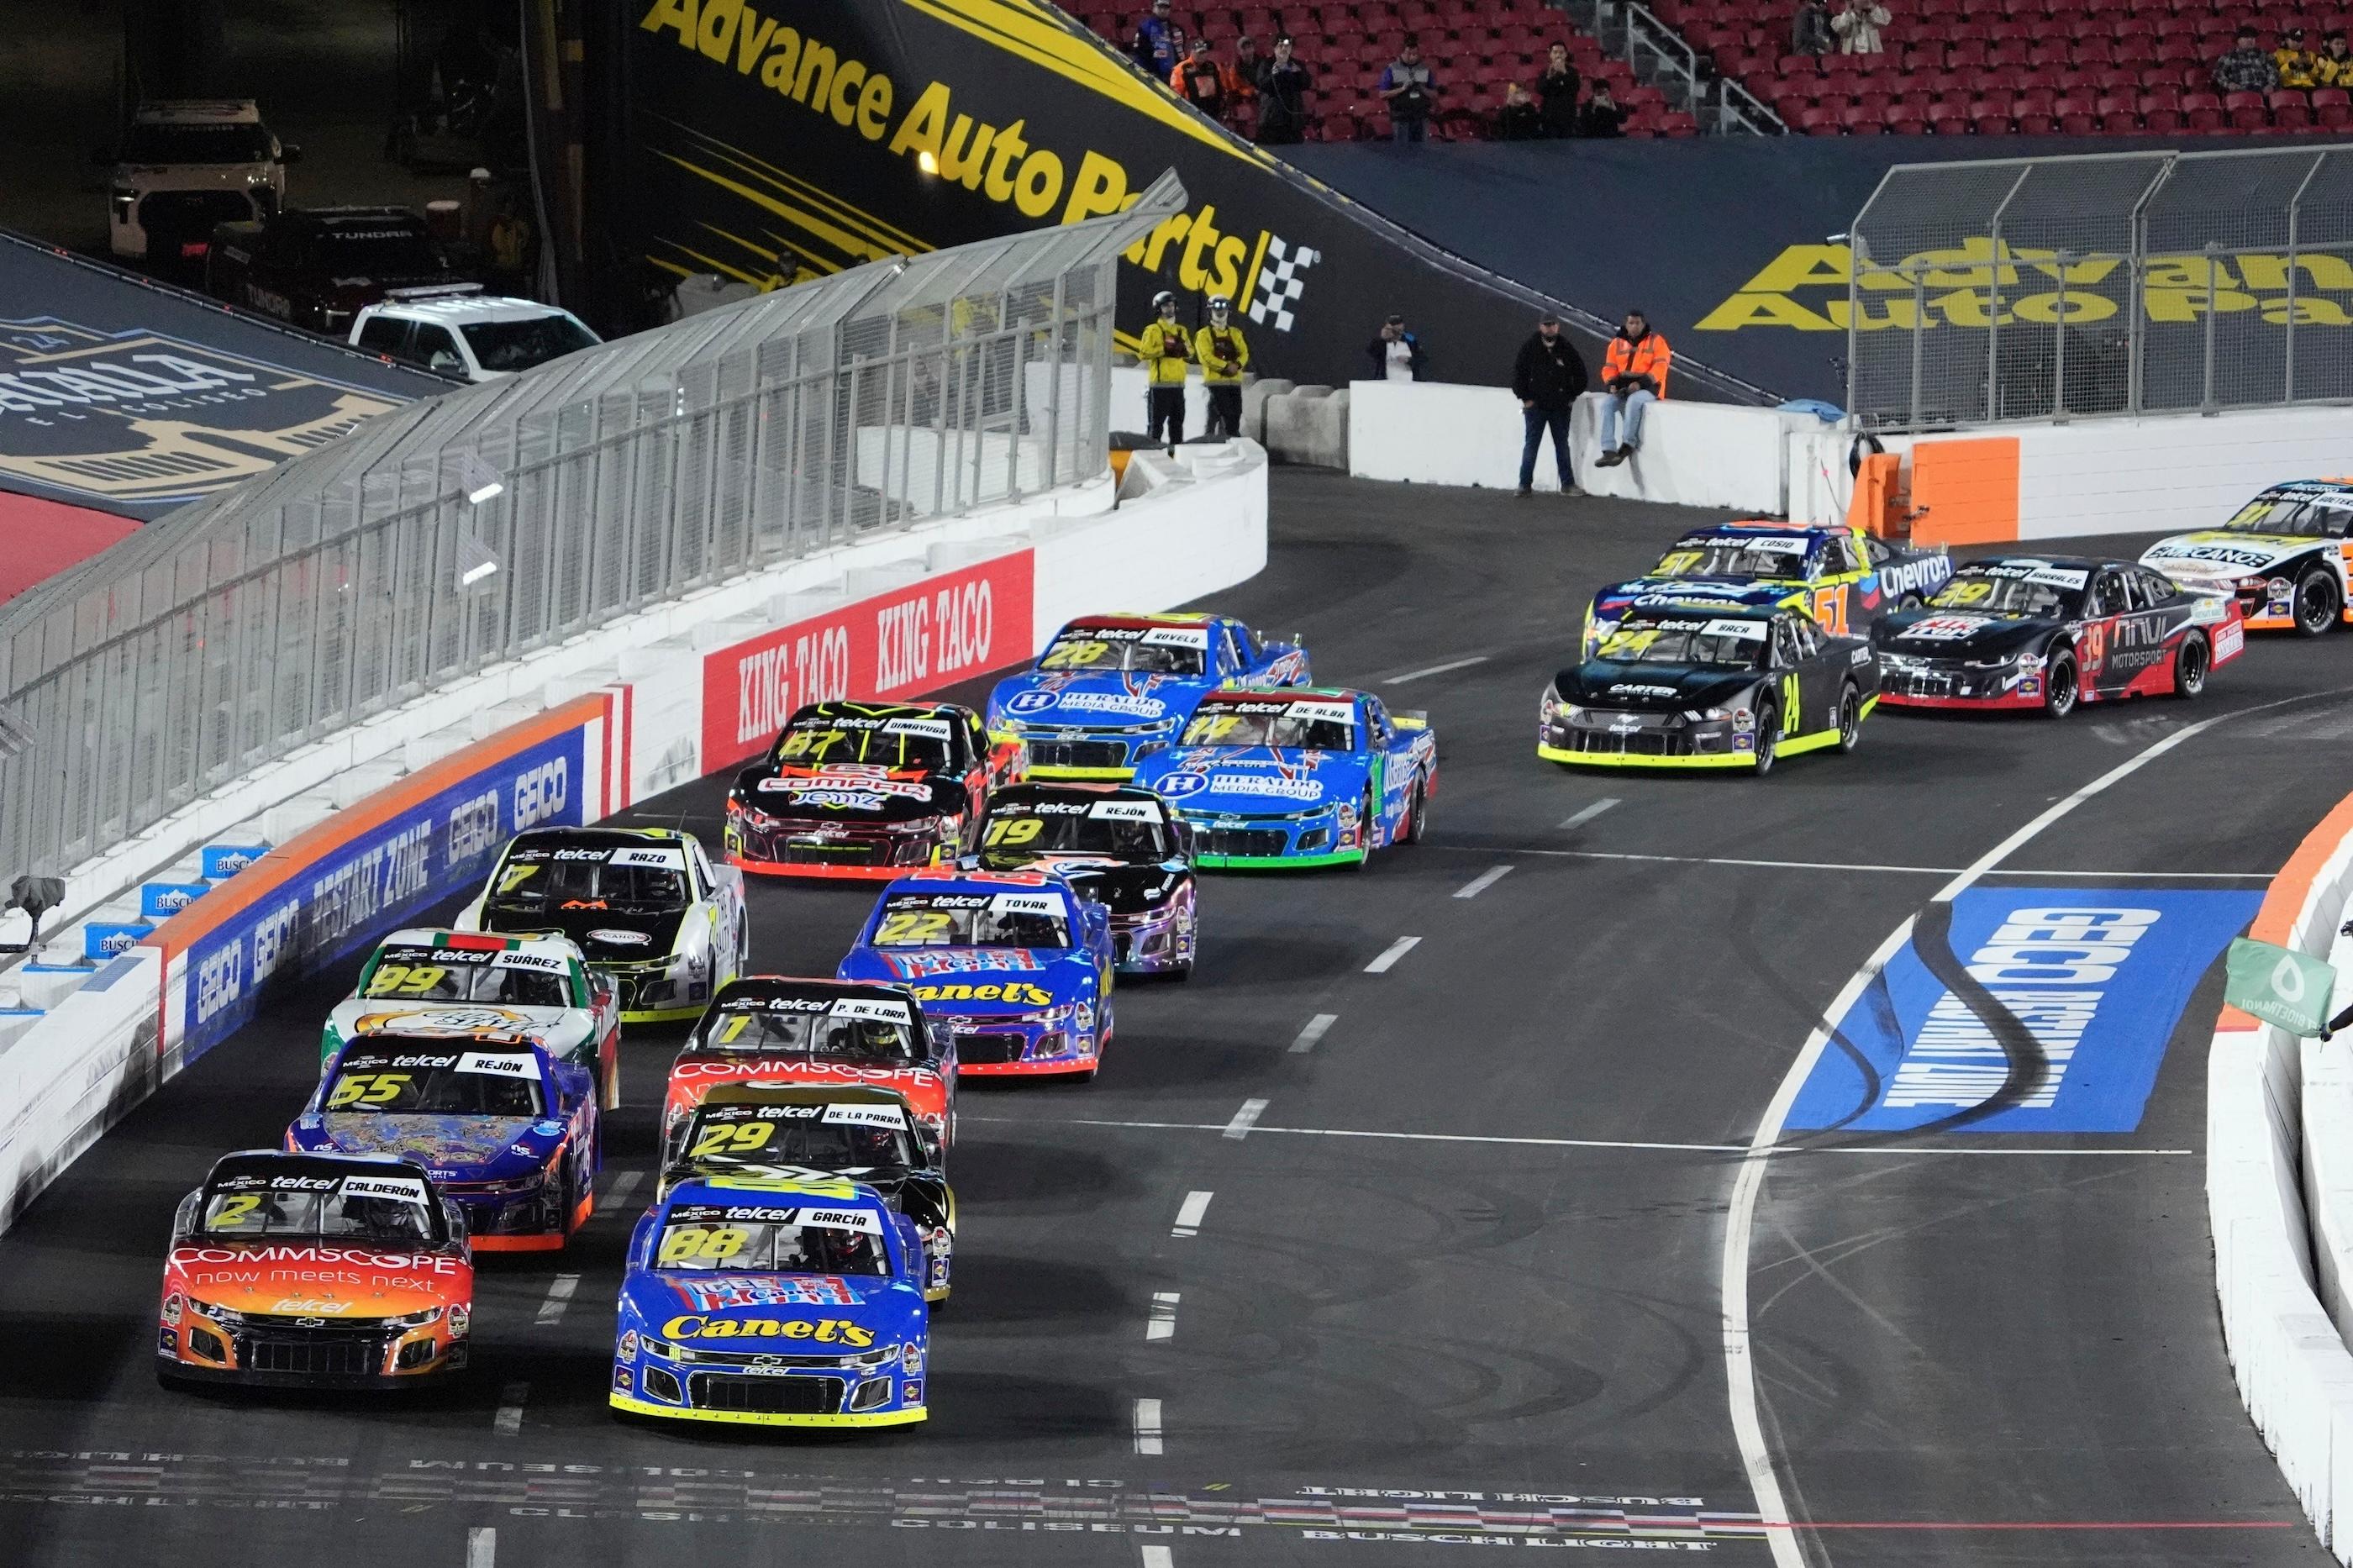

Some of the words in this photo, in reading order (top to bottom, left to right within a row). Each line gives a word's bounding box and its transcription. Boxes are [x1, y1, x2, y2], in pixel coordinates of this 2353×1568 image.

[641, 0, 894, 140] Advance
[888, 82, 1064, 218] Auto
[332, 230, 412, 241] TUNDRA
[1693, 292, 2118, 330] Auto
[0, 355, 255, 414] ATALLA
[120, 388, 266, 412] COLISEO
[1880, 555, 1951, 598] Chevron
[2031, 571, 2082, 585] BARRALES
[1814, 583, 1850, 634] 51
[875, 597, 929, 694] KING
[935, 578, 992, 673] TACO
[1094, 629, 1146, 640] telcel
[1154, 633, 1199, 644] ROVELO
[1656, 619, 1707, 631] telcel
[1717, 624, 1750, 634] BACA
[1039, 641, 1109, 667] 28
[1851, 646, 1871, 665] CARTER
[2082, 624, 2104, 672] 39
[2112, 650, 2168, 670] MOTORSPORT
[737, 643, 789, 745] KING
[795, 625, 849, 708] TACO
[1608, 683, 1677, 696] CARTER
[1061, 700, 1108, 710] MEDIA
[1109, 703, 1160, 717] GROUP
[1065, 692, 1165, 710] HERALDO
[1234, 702, 1290, 713] telcel
[1295, 706, 1313, 714] DE
[1315, 708, 1346, 718] ALBA
[1782, 672, 1801, 734] 24
[832, 717, 887, 729] telcel
[889, 721, 949, 735] DIMAYUGA
[513, 756, 566, 831] GEICO
[1213, 784, 1260, 793] MEDIA
[1265, 787, 1319, 798] GROUP
[1214, 775, 1321, 790] HERALDO
[1034, 802, 1092, 815] telcel
[1104, 806, 1147, 818] REJÓN
[448, 789, 500, 866] GEICO
[984, 818, 1045, 847] 19
[216, 860, 254, 871] BUSC
[382, 818, 432, 909] ZONE
[552, 848, 612, 861] telcel
[629, 851, 667, 864] RAZO
[497, 865, 541, 895] 7
[930, 896, 992, 908] telcel
[1004, 899, 1049, 911] TOVAR
[873, 913, 952, 945] 22
[253, 898, 300, 985] GEICO
[1964, 908, 2162, 984] GEICO
[384, 950, 428, 961] MÉXICO
[430, 949, 493, 963] telcel
[502, 953, 563, 970] SUÁREZ
[197, 939, 243, 1024] GEICO
[363, 966, 450, 997] 99
[906, 981, 1054, 1007] anel's
[720, 999, 766, 1009] MÉXICO
[768, 997, 832, 1013] telcel
[836, 1004, 849, 1013] P.
[854, 1006, 871, 1015] DE
[875, 1007, 907, 1020] LARA
[718, 1015, 754, 1044] 1
[952, 1024, 980, 1034] lcel
[343, 1056, 389, 1068] MÉXICO
[391, 1054, 458, 1068] telcel
[474, 1058, 524, 1073] REJÓN
[673, 1060, 934, 1088] COMMSCOPE
[326, 1073, 413, 1108] 55
[705, 1108, 754, 1120] MÉXICO
[755, 1106, 824, 1119] telcel
[828, 1110, 845, 1119] DE
[847, 1112, 862, 1120] LA
[865, 1113, 903, 1125] PARRA
[688, 1122, 776, 1158] 29
[427, 1169, 458, 1177] ORTS
[216, 1178, 267, 1188] MÉXICO
[269, 1175, 339, 1191] telcel
[345, 1181, 421, 1199] CALDERÓN
[207, 1195, 262, 1229] 2
[671, 1207, 722, 1219] MÉXICO
[724, 1206, 796, 1221] telcel
[811, 1211, 867, 1227] GARCÍA
[658, 1228, 750, 1262] 88
[170, 1247, 458, 1276] COMMSCOPE
[196, 1270, 261, 1286] now
[271, 1269, 361, 1285] meets
[371, 1274, 435, 1293] next
[270, 1298, 354, 1314] telcel
[661, 1314, 876, 1348] Canel's
[668, 1346, 681, 1360] 88
[742, 1365, 790, 1376] telcel
[891, 1518, 1242, 1537] COLISEUM
[1301, 1529, 1517, 1547] BUSCH
[1524, 1536, 1718, 1552] LIGHT
